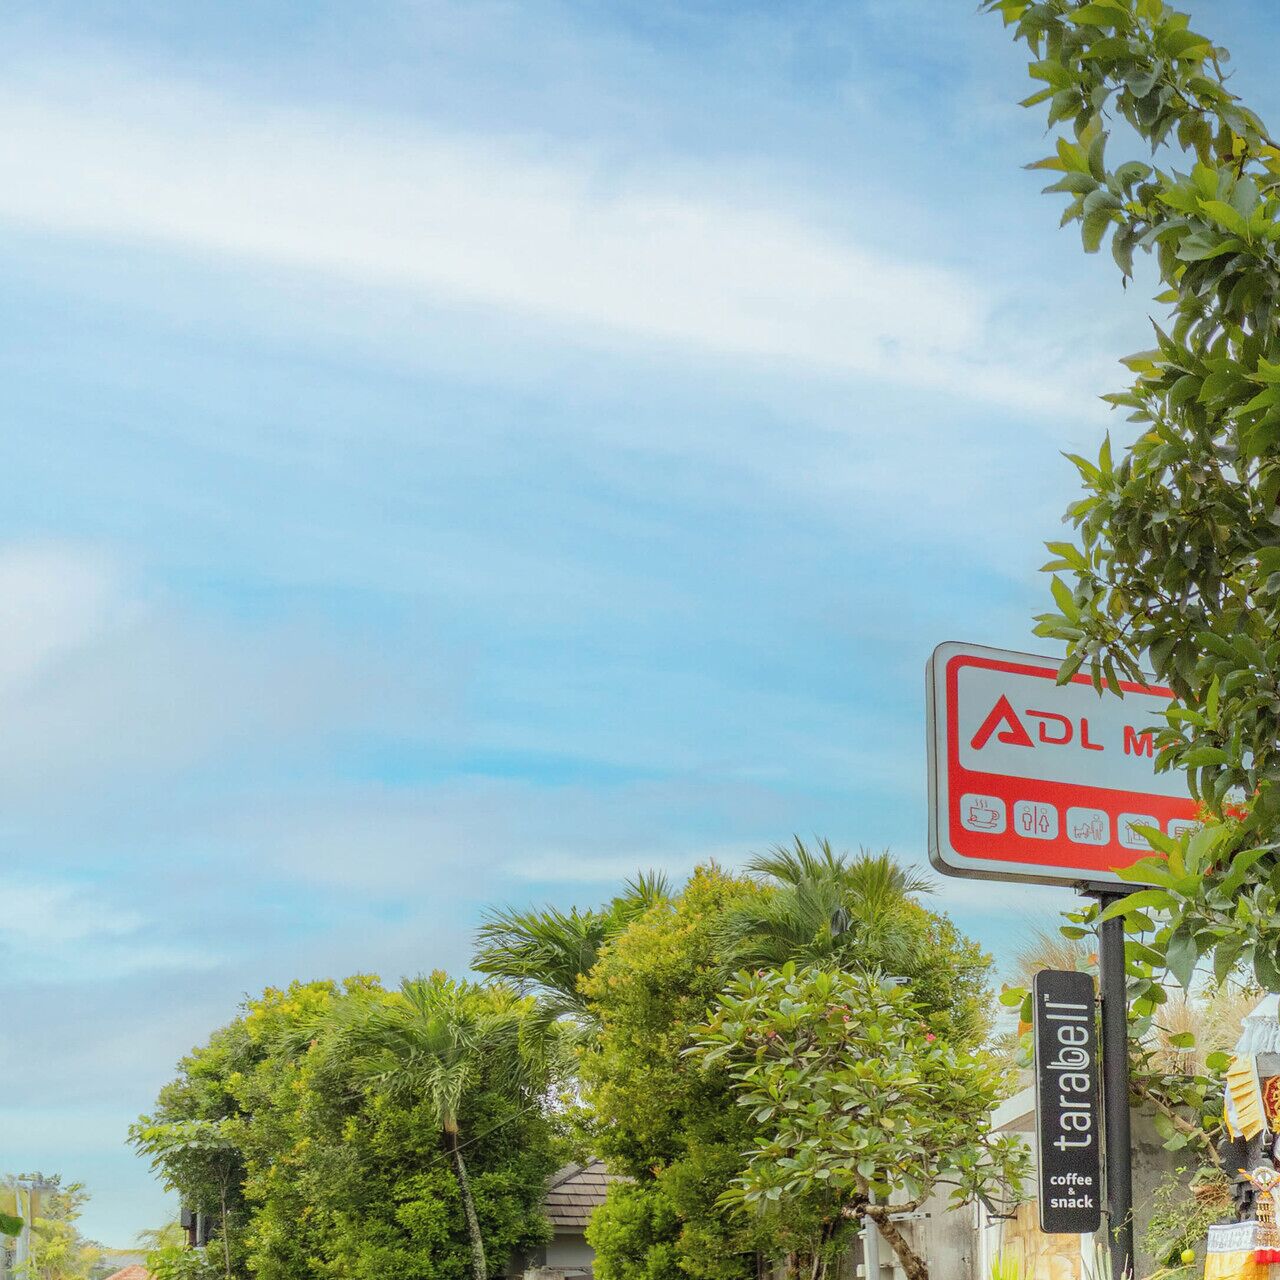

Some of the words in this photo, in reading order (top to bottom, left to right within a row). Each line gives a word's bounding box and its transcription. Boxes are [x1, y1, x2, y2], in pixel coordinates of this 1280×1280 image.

[970, 693, 1105, 752] ADL
[1046, 1001, 1092, 1152] tarabell
[1050, 1173, 1092, 1186] coffee
[1068, 1187, 1075, 1195] &
[1050, 1195, 1093, 1209] snack
